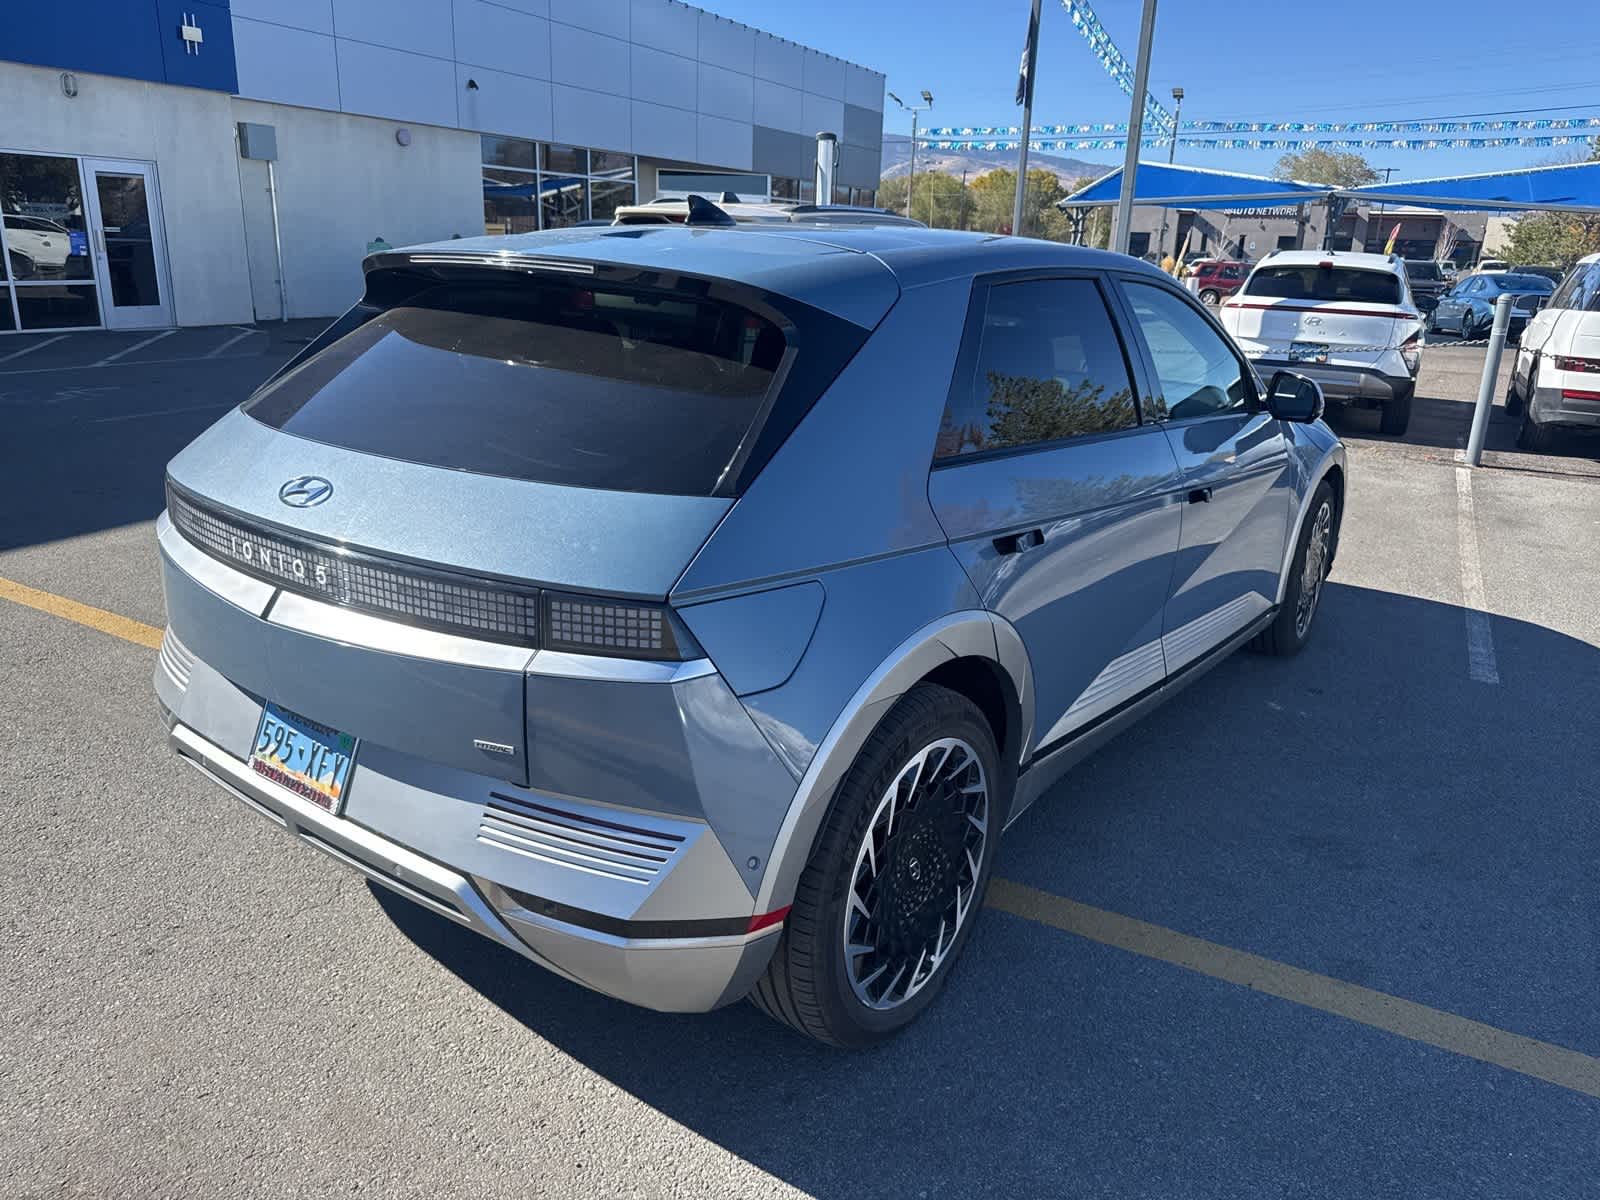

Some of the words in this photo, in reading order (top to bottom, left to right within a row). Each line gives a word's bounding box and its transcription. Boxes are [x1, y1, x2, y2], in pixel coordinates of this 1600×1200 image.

[1256, 207, 1298, 216] NETWORK
[231, 536, 305, 579] IONIQ
[315, 563, 328, 585] 5
